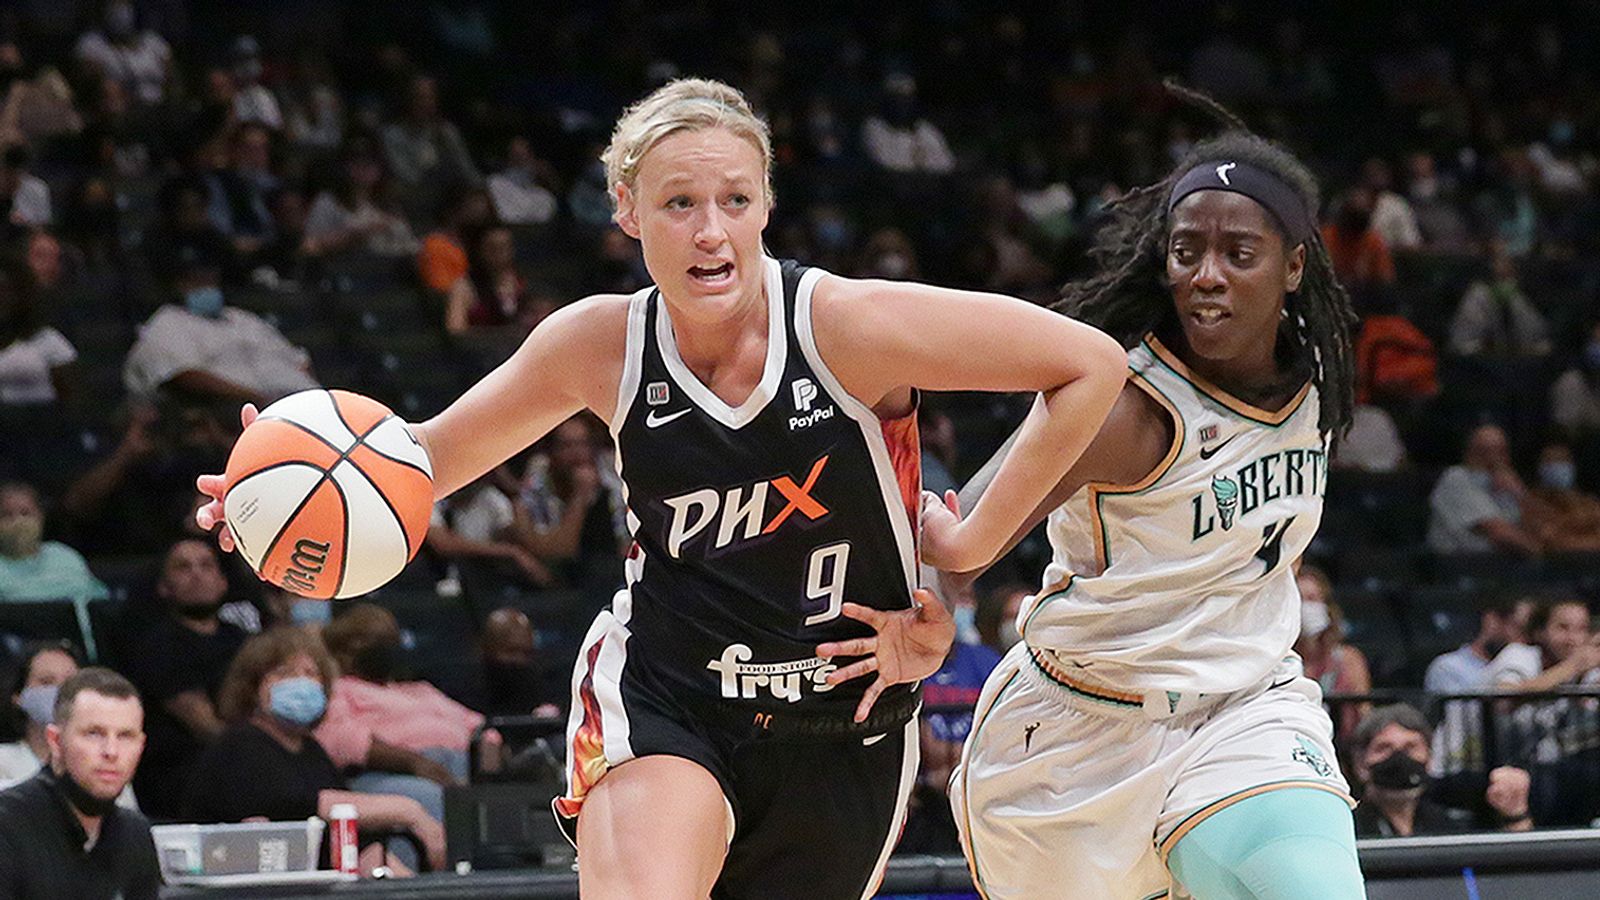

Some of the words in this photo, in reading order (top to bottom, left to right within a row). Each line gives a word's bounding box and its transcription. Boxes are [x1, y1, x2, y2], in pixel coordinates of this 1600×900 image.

[788, 404, 834, 430] PayPal
[663, 454, 830, 559] PHX
[281, 538, 332, 593] Wil
[806, 541, 851, 626] 9
[706, 643, 838, 703] fry's
[739, 664, 776, 673] FOOD
[780, 656, 830, 672] STORE
